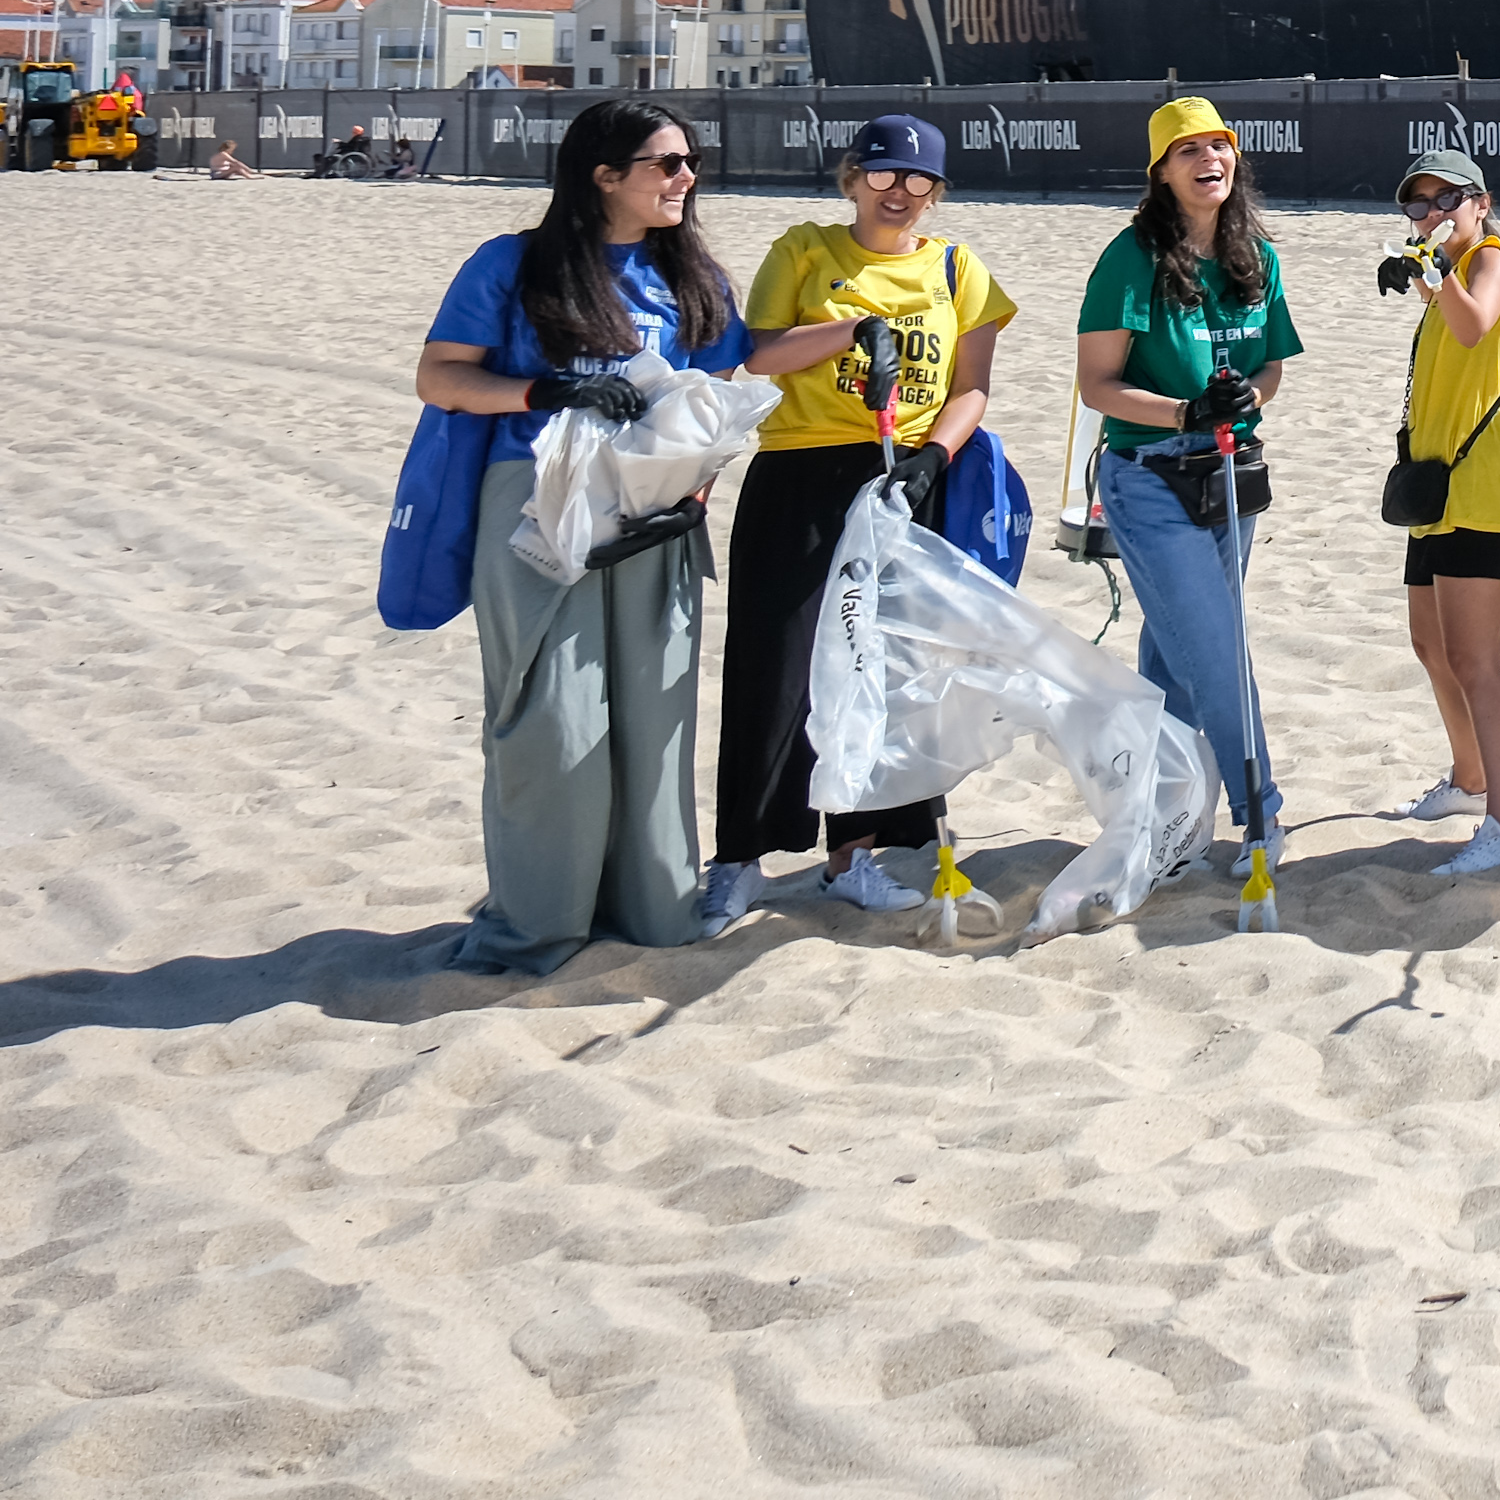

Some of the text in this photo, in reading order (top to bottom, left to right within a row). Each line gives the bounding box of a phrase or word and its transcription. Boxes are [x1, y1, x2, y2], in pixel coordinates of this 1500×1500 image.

[783, 120, 807, 148] LIGA
[962, 120, 1081, 150] LIGA PORTUGAL
[1408, 121, 1447, 155] LIGA
[895, 316, 924, 328] POR
[905, 367, 938, 386] PELA
